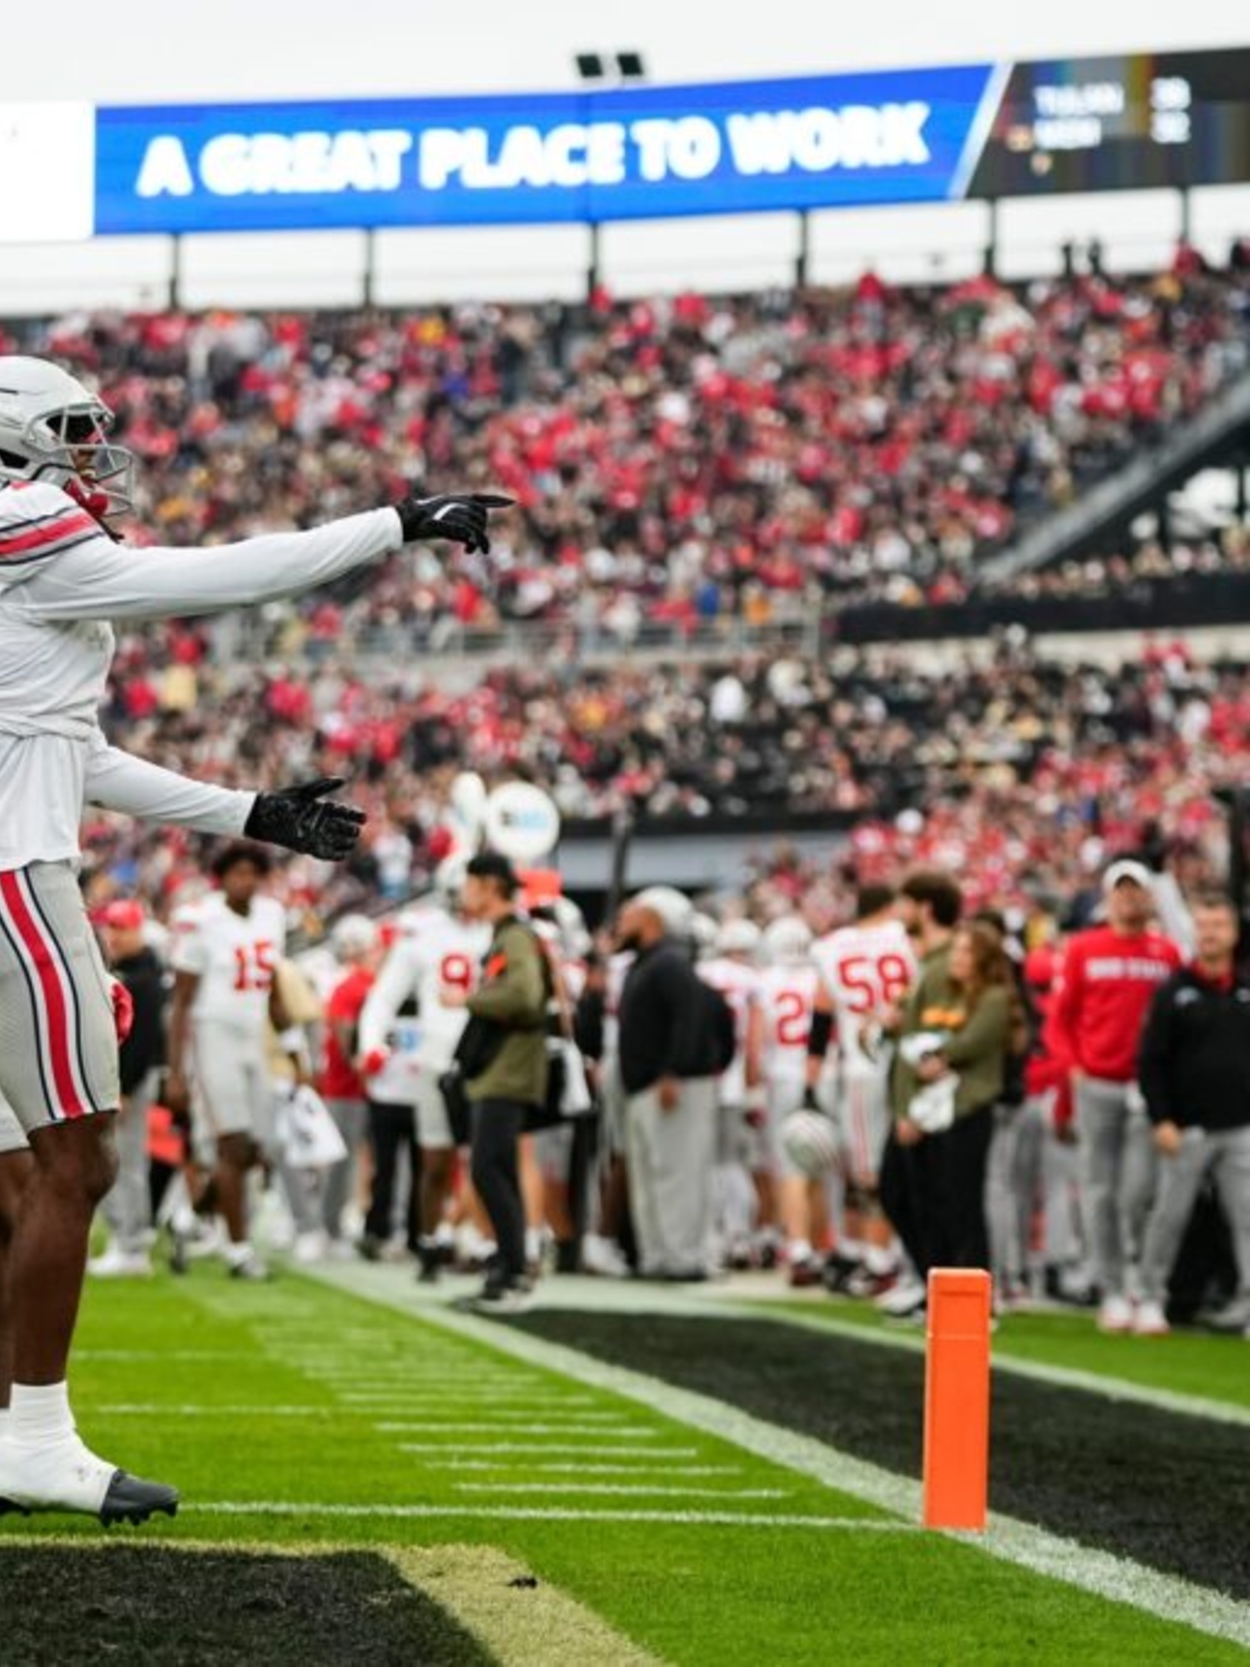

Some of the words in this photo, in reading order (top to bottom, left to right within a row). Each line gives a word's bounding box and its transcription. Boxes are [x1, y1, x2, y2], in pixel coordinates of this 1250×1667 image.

[135, 135, 193, 197] A
[199, 129, 412, 195] GREAT
[419, 122, 625, 189] PLACE
[631, 115, 721, 181] TO
[727, 102, 930, 174] WORK
[234, 940, 274, 991] 15
[839, 954, 910, 1014] 58
